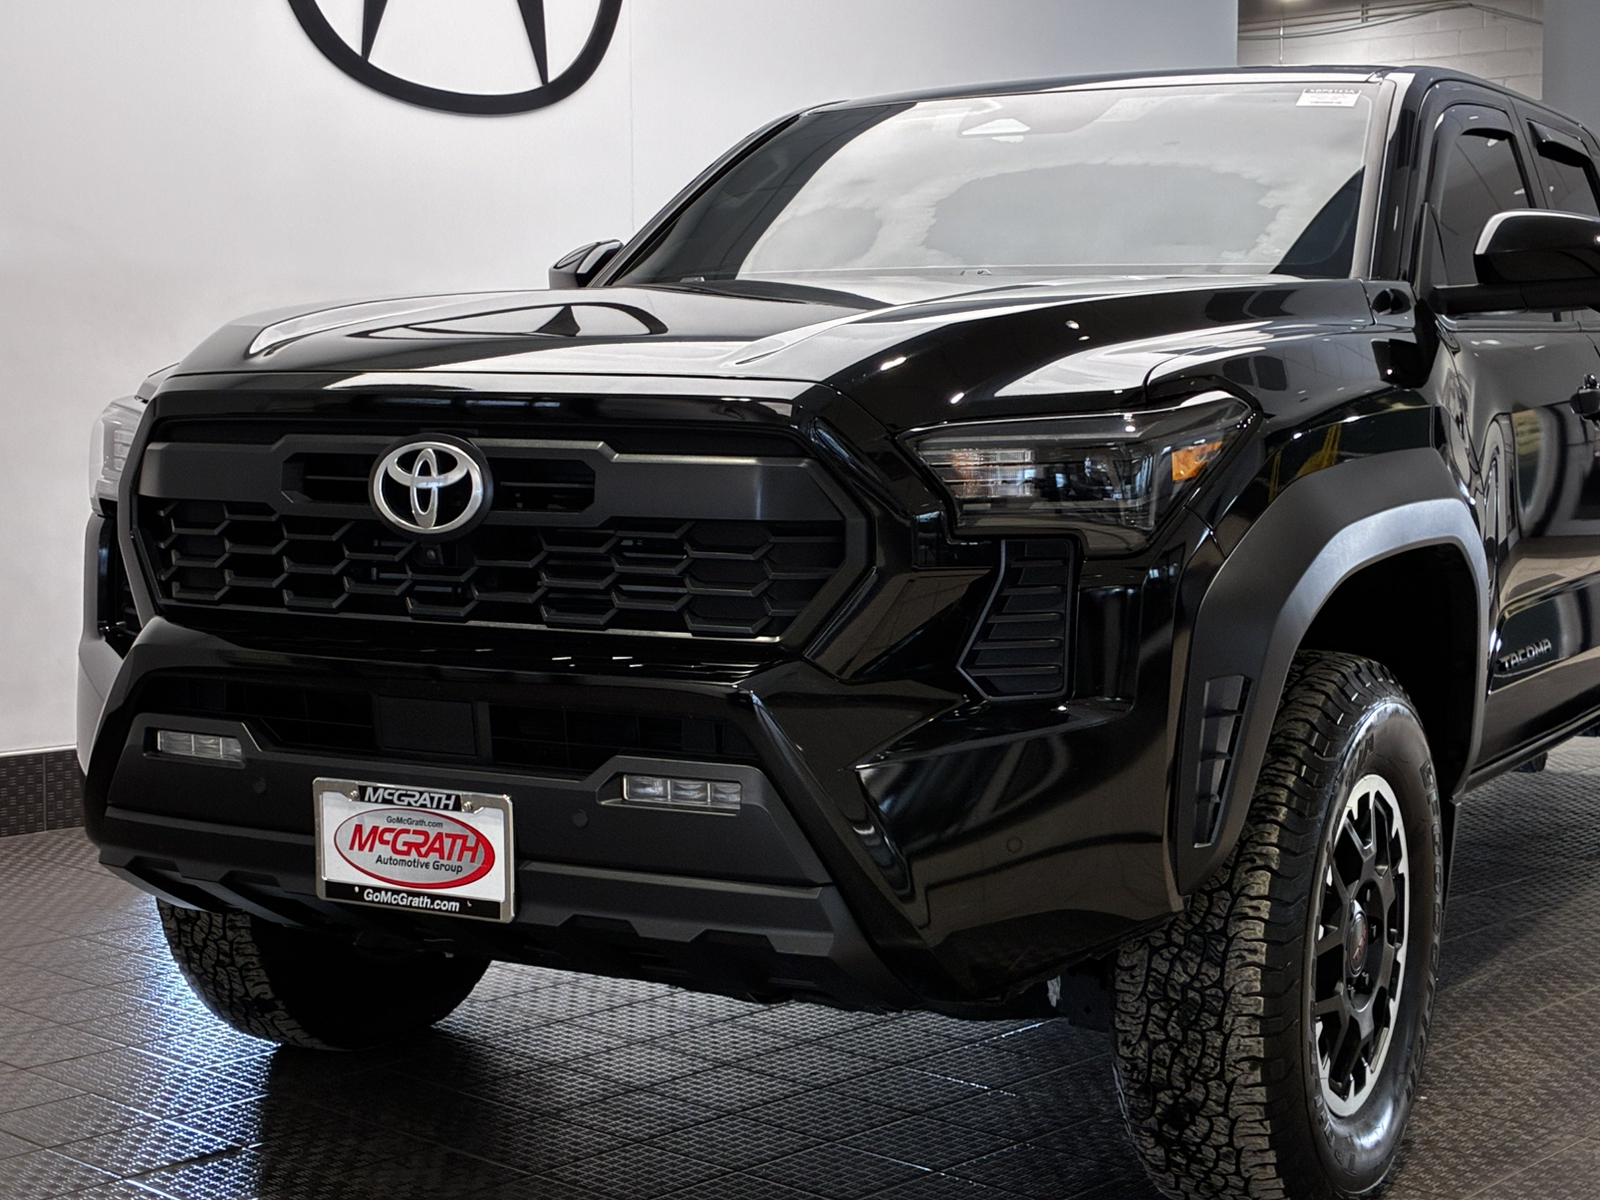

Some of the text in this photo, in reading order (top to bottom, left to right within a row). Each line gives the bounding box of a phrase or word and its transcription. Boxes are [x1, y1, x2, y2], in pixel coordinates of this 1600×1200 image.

[1499, 638, 1552, 669] TACOMA
[386, 815, 444, 828] GoMcGrath.com
[375, 855, 463, 875] Automotive Group
[363, 888, 460, 912] GoMcGrath.com
